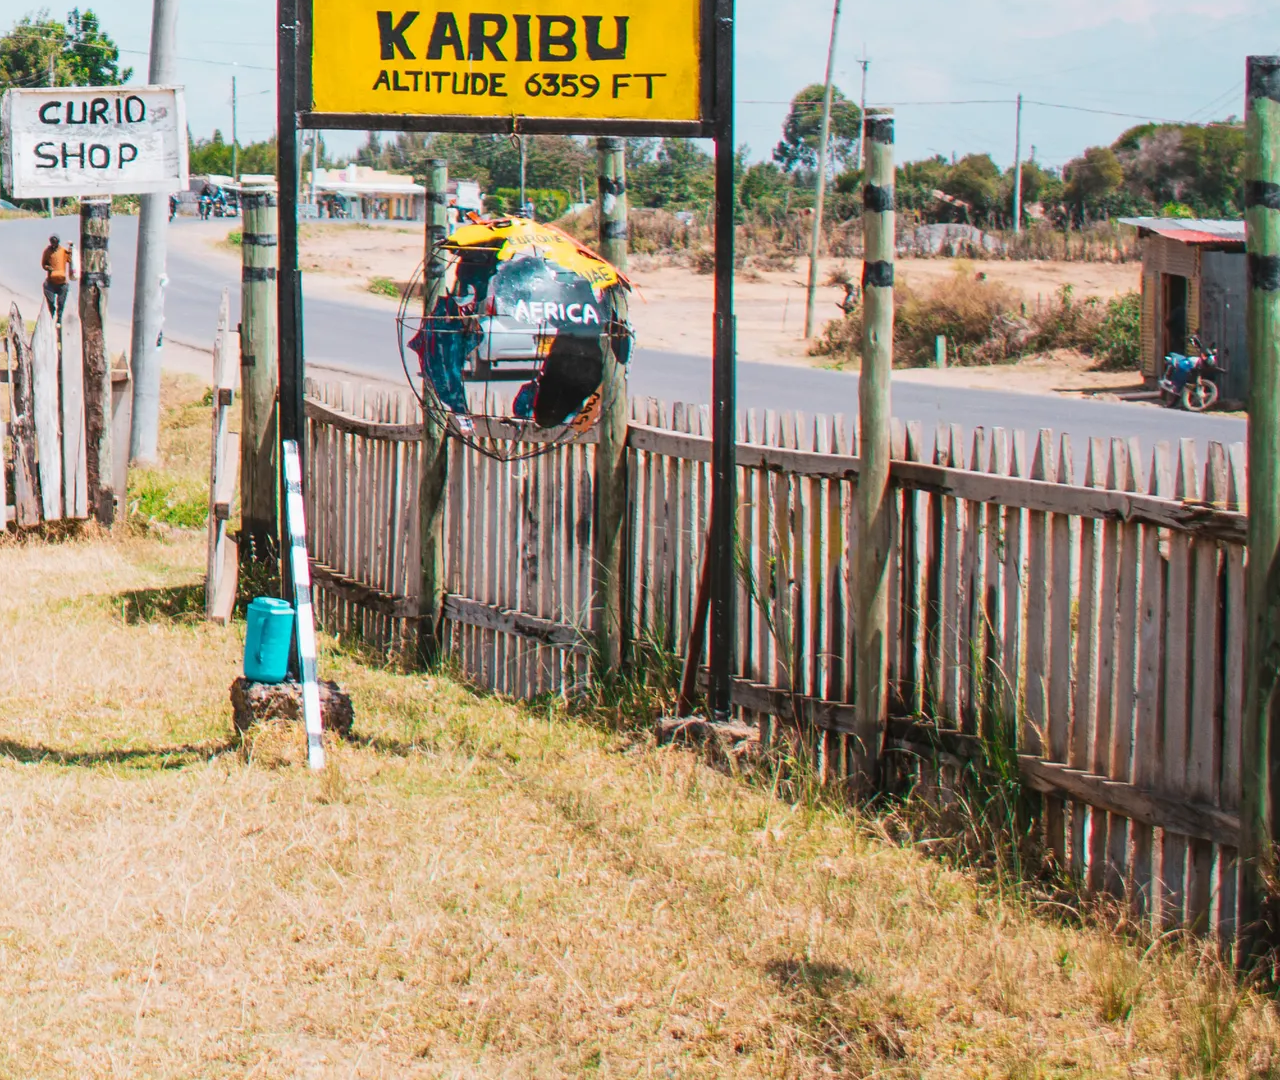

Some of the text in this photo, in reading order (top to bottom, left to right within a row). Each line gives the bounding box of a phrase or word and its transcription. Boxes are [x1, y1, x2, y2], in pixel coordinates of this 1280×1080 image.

[376, 11, 630, 62] KARIBU
[372, 70, 667, 100] ALTITUDE 6359 FT
[38, 95, 146, 125] CURIO
[33, 141, 138, 169] SHOP
[514, 299, 600, 325] AFRICA
